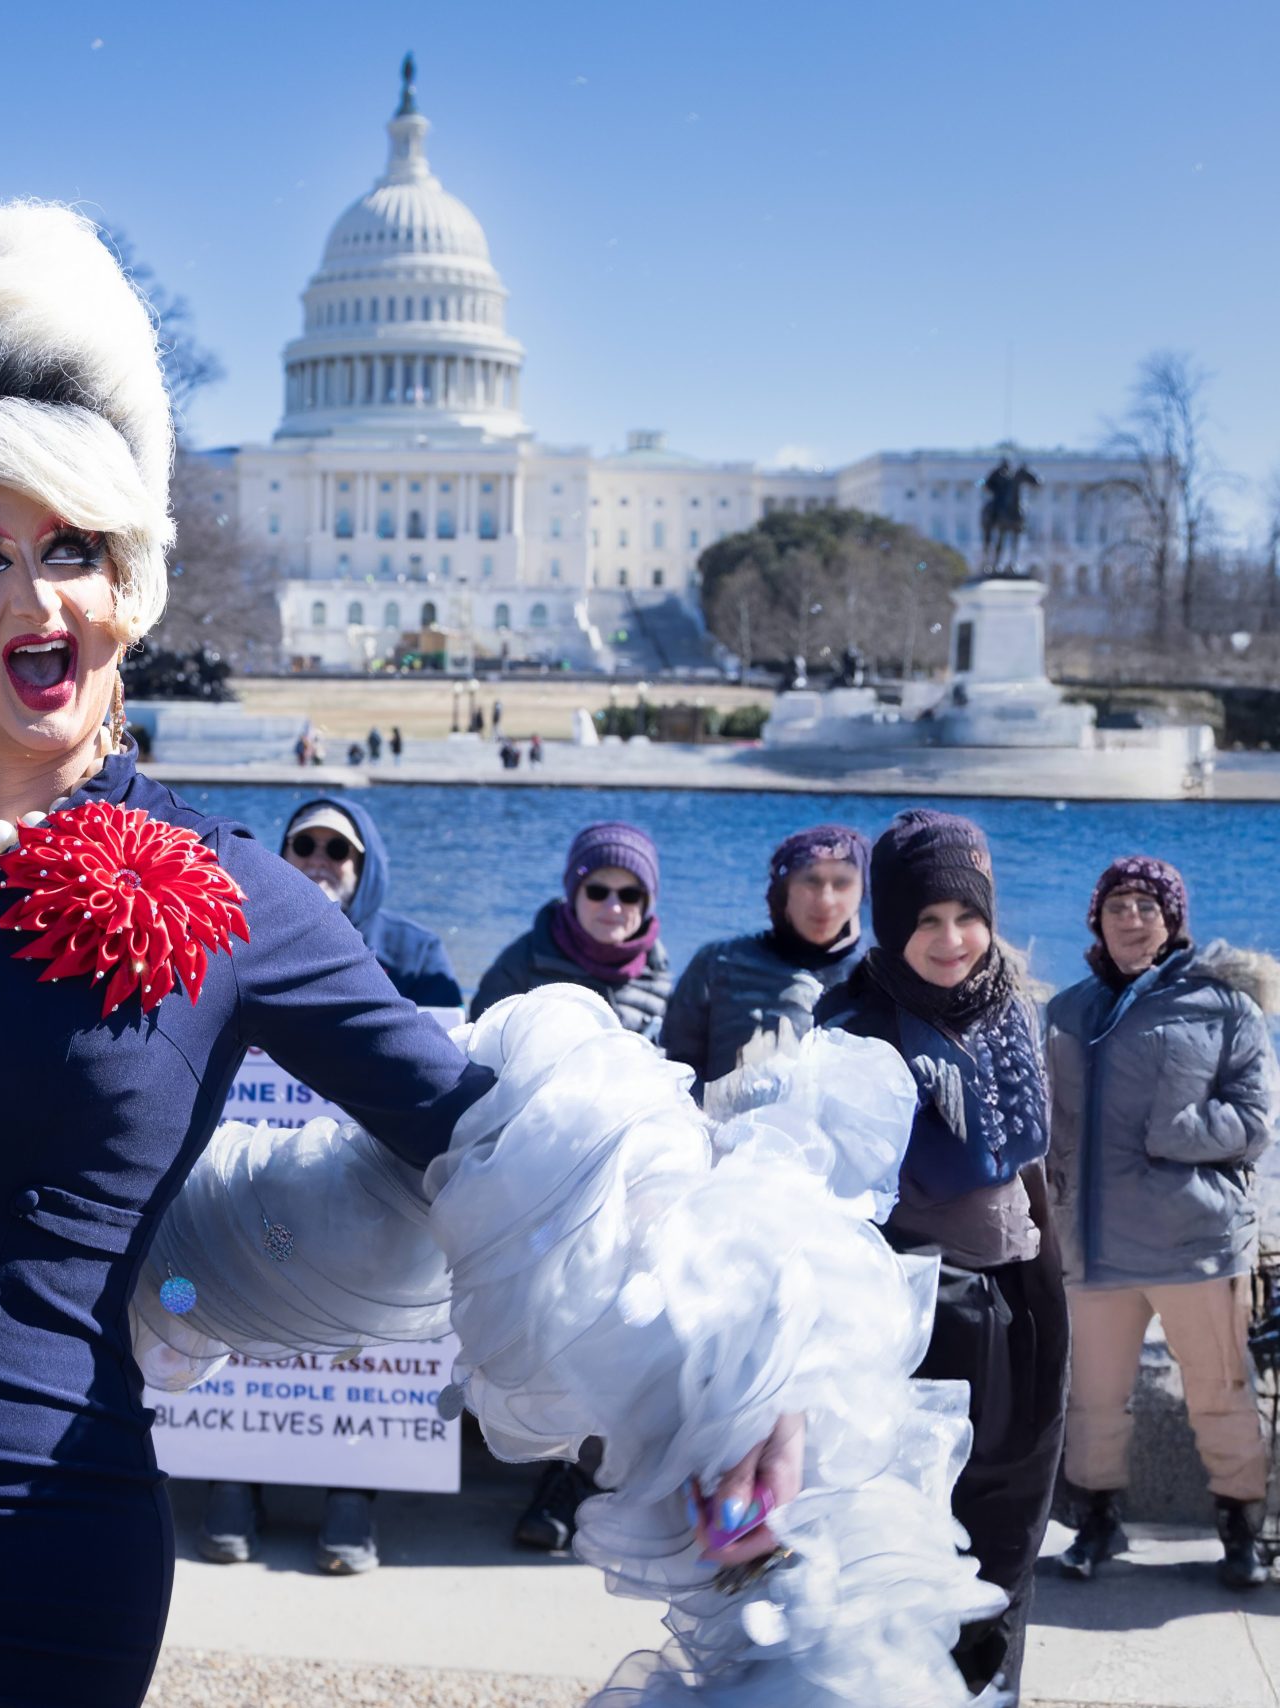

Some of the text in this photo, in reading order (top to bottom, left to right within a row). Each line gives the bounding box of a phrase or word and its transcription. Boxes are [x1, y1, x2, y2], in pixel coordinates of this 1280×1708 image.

[286, 1084, 313, 1104] IS
[330, 1356, 441, 1376] ASSAULT
[246, 1381, 335, 1402] PEOPLE
[154, 1404, 447, 1441] BLACK LIVES MATTER
